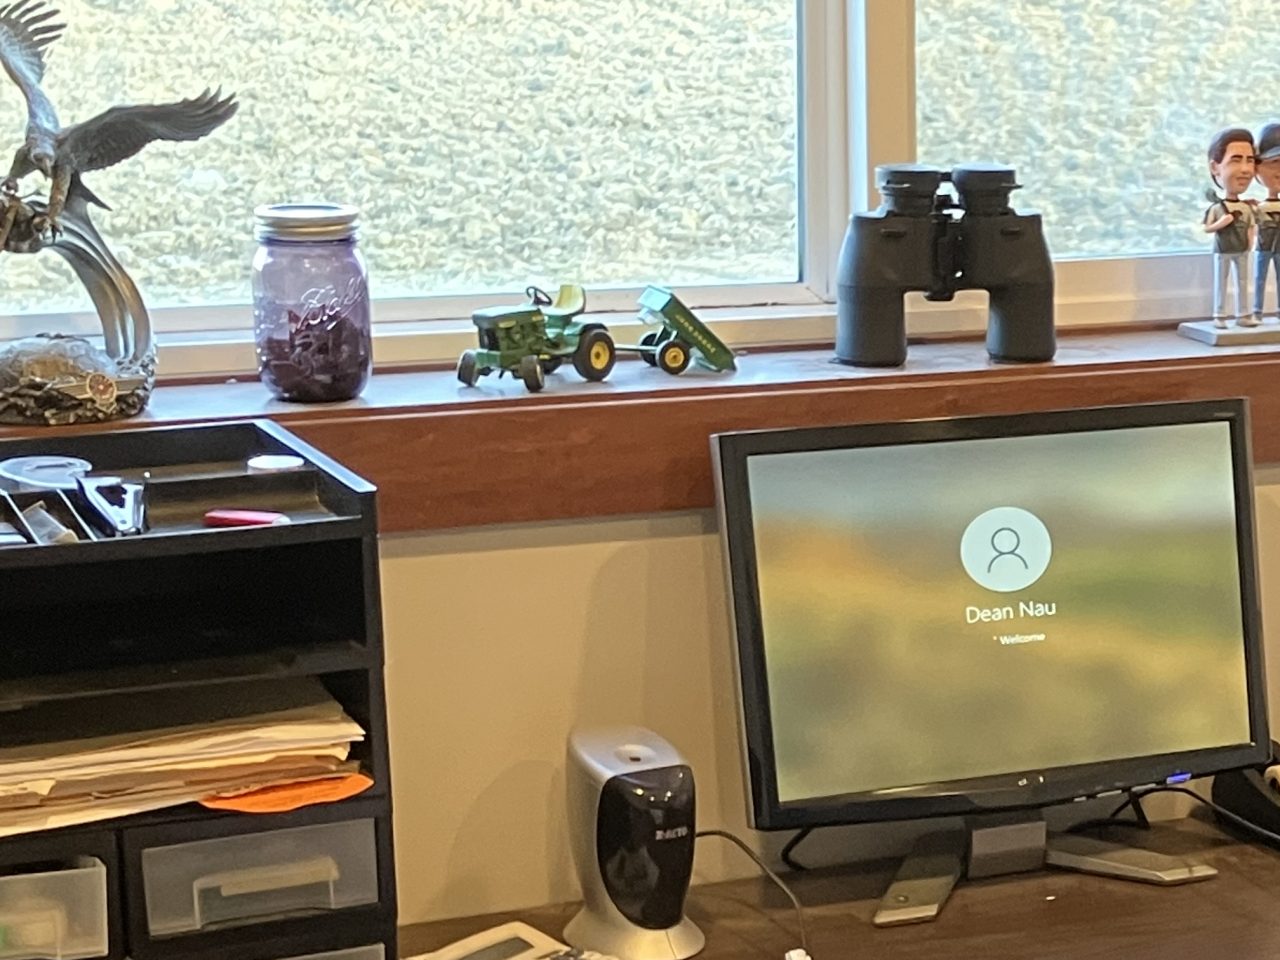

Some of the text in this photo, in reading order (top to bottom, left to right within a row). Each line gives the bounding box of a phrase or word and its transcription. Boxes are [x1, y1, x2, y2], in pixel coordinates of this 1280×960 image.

[966, 601, 1056, 624] Dean Nau
[1000, 633, 1046, 645] Welcome
